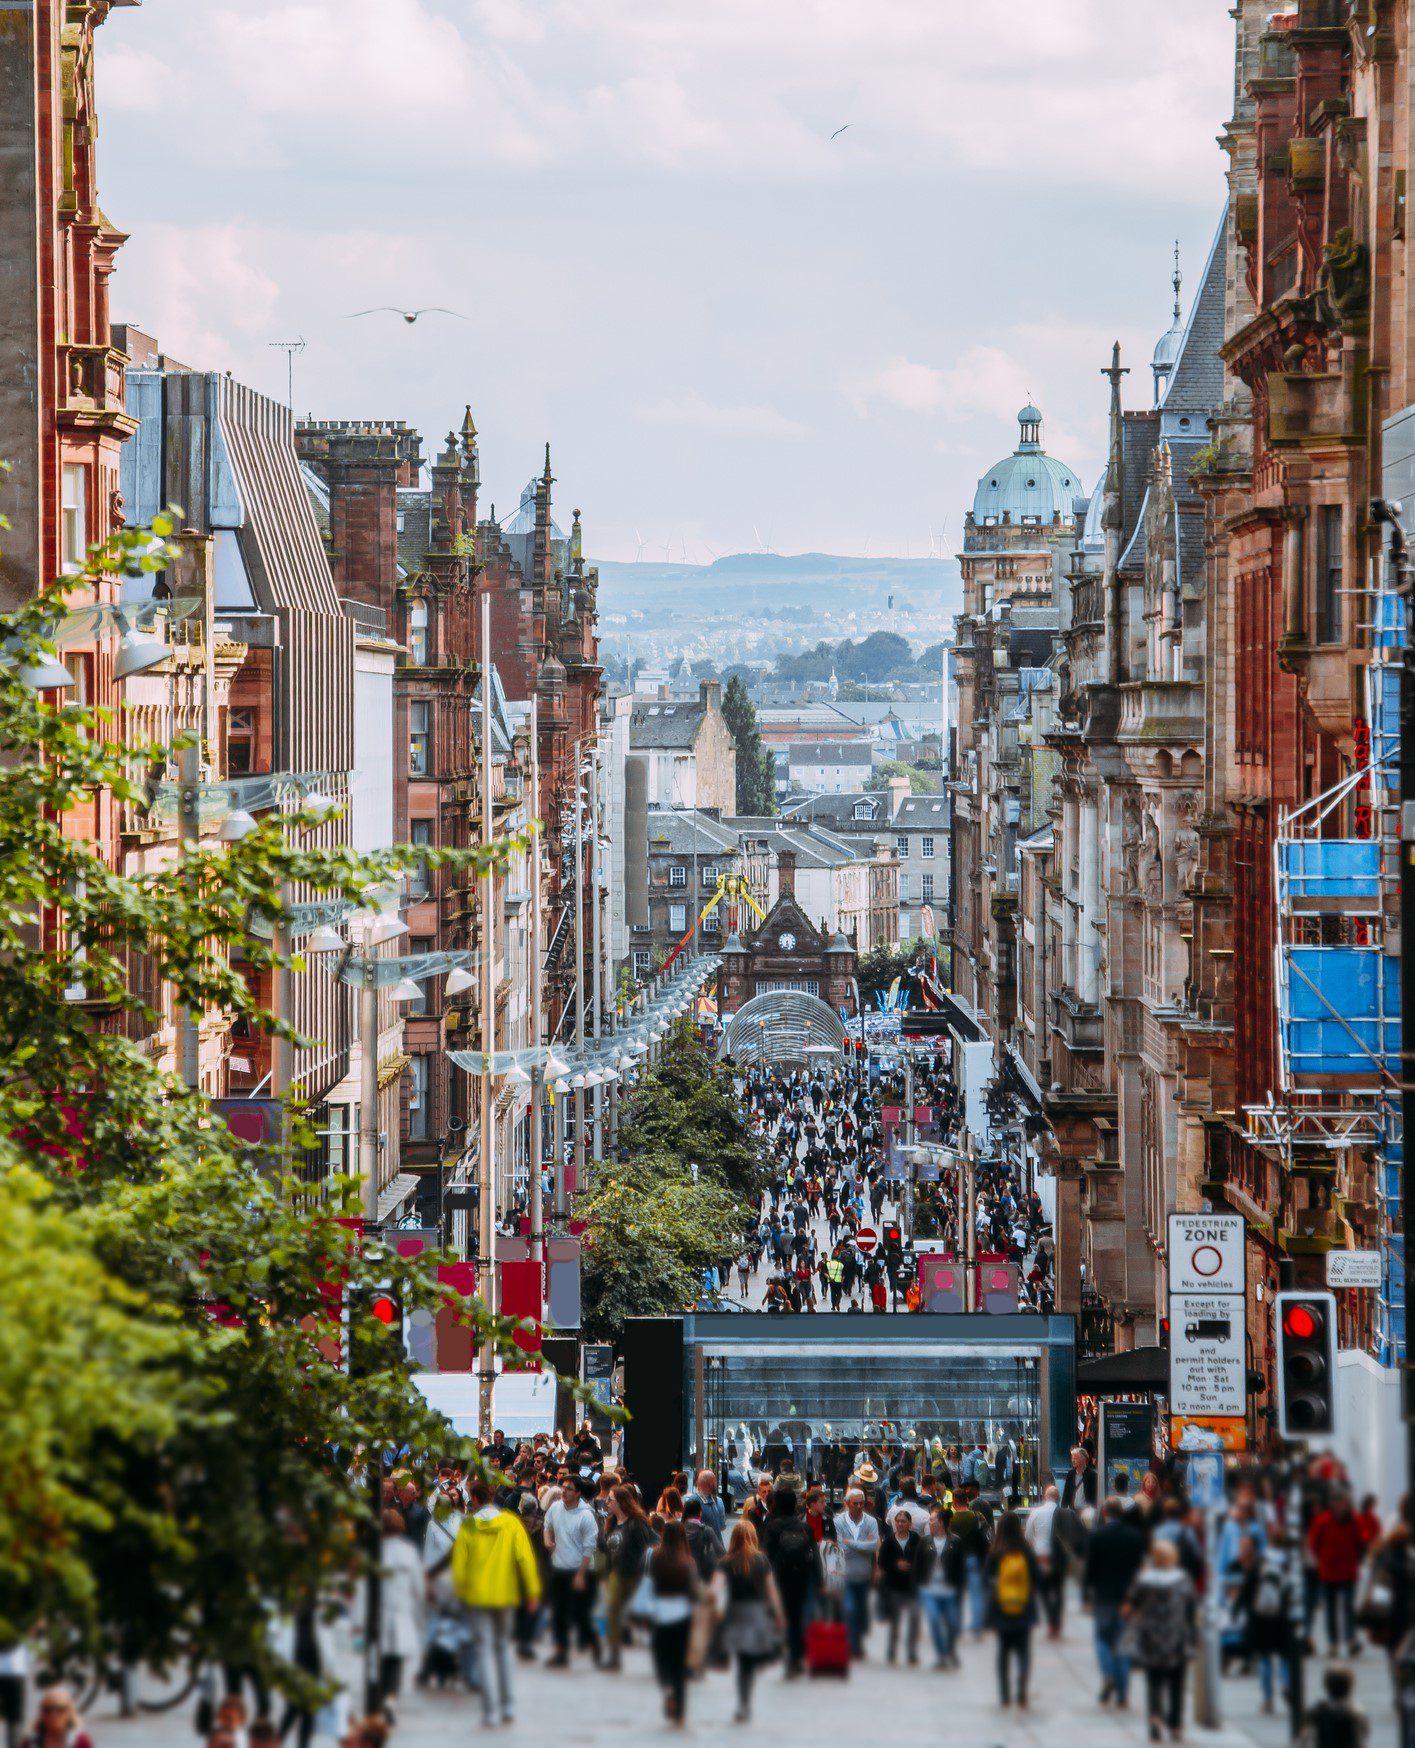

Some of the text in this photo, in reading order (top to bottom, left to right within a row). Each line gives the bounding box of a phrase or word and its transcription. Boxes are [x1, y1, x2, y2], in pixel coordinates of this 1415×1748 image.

[1176, 1220, 1238, 1228] PEDESTRIAN
[1185, 1230, 1228, 1242] ZONE
[1182, 1280, 1233, 1288] No vehicles
[1184, 1300, 1230, 1309] Except for
[1184, 1310, 1230, 1319] loading by
[1175, 1357, 1204, 1365] permit
[1187, 1375, 1229, 1383] Mon Sat
[1181, 1384, 1192, 1392] 10
[1214, 1384, 1220, 1392] 5
[1221, 1385, 1235, 1393] pm
[1200, 1393, 1217, 1401] Sun
[1226, 1404, 1240, 1412] pm
